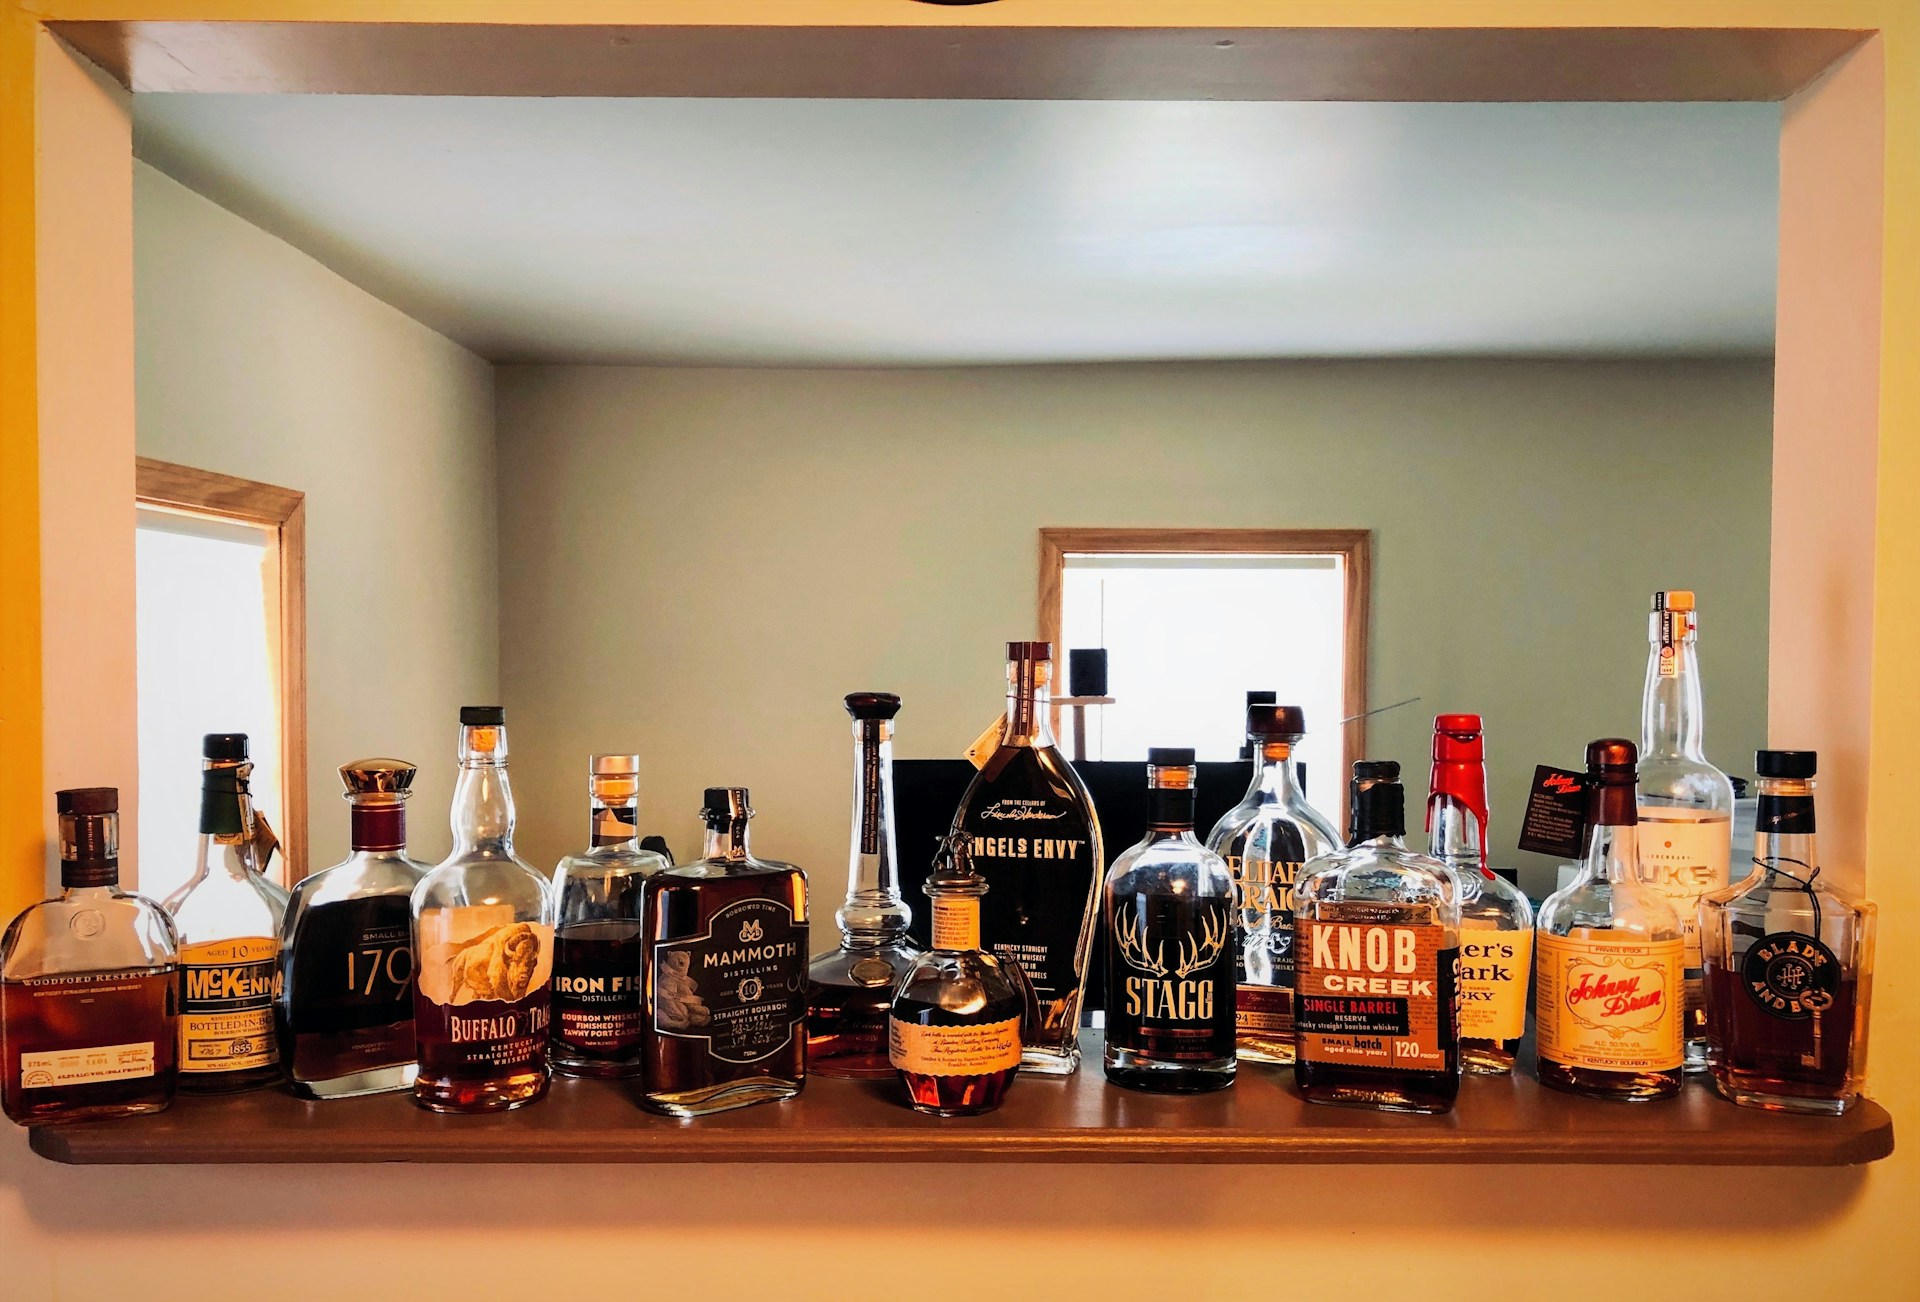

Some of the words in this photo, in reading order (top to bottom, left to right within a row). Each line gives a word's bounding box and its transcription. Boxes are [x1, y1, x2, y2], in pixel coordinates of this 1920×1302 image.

[1033, 838, 1077, 860] ENVY
[1638, 863, 1707, 887] UKE
[725, 903, 761, 919] BORROWED
[762, 904, 776, 912] TIME
[1269, 915, 1295, 930] Batc
[362, 931, 396, 941] SMALL
[207, 950, 229, 958] AGED
[231, 945, 249, 960] 10
[703, 941, 797, 968] MAMMOTH
[993, 943, 1021, 952] KENTUCKY
[1021, 945, 1048, 953] STRAIGHT
[1312, 924, 1417, 974] KNOB
[1461, 943, 1514, 958] er's
[1757, 941, 1828, 968] BLADE
[1022, 953, 1046, 963] WHISKEY
[23, 976, 92, 987] WOODFORD
[95, 971, 153, 983] RESERVE
[348, 946, 414, 1001] 179
[723, 964, 779, 979] DISTILLING
[1462, 964, 1512, 981] ark
[556, 976, 604, 993] IRON
[612, 975, 640, 993] FIS
[743, 983, 757, 995] 10
[1323, 974, 1434, 996] CREEK
[1568, 973, 1641, 1005] Johnny
[582, 994, 627, 1003] DISTILLERY
[1126, 975, 1214, 1020] STAGG
[1461, 991, 1496, 1002] SKY
[1751, 981, 1786, 1010] AND
[1303, 998, 1345, 1014] SINGLE
[1350, 1000, 1399, 1015] BARREL
[1600, 989, 1662, 1018] Drum
[562, 1013, 601, 1022] BOURBON
[602, 1012, 641, 1022] WHISKE
[713, 1008, 749, 1021] STRAIGHT
[751, 1003, 788, 1014] BOURBON
[731, 1014, 770, 1025] WHISKEY
[1334, 1014, 1367, 1023] RESERVE
[190, 1015, 275, 1031] BOTTLED-IN-BO
[450, 1015, 516, 1043] BUFFALO
[529, 1002, 551, 1034] TRAC
[576, 1022, 614, 1030] FINISHED
[615, 1021, 625, 1029] IN
[1317, 1022, 1343, 1032] straight
[1372, 1023, 1399, 1033] whiskey
[563, 1028, 590, 1038] TAWNY
[590, 1029, 614, 1038] PORT
[229, 1043, 252, 1055] 1855
[466, 1050, 514, 1061] STRAIGHT
[518, 1040, 546, 1055] BOURBON
[490, 1038, 534, 1052] KENTUCKY
[1321, 1037, 1351, 1047] SMALL
[1354, 1036, 1382, 1050] batch
[1395, 1041, 1420, 1058] 120
[1324, 1046, 1344, 1055] aged
[1366, 1049, 1388, 1057] years
[493, 1053, 531, 1066] WHISKEY
[1587, 1058, 1618, 1066] KENTUCKY
[1620, 1059, 1648, 1067] BOURBON
